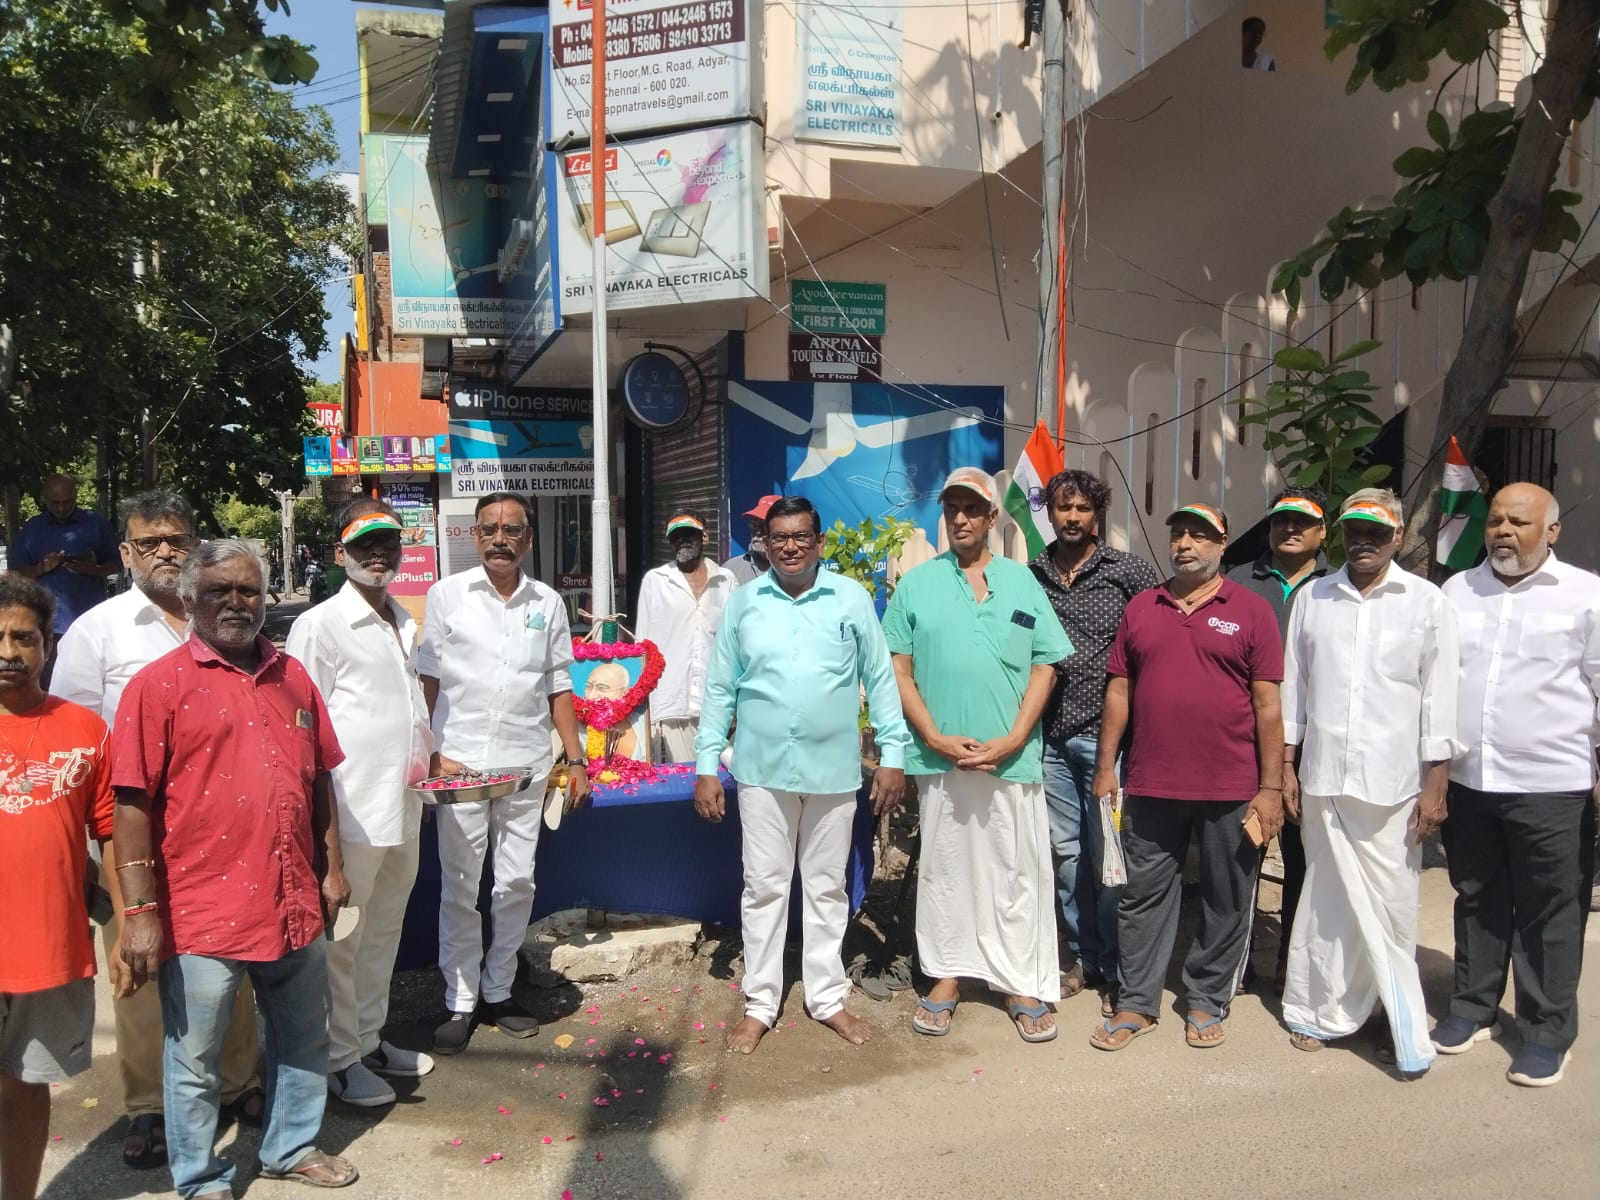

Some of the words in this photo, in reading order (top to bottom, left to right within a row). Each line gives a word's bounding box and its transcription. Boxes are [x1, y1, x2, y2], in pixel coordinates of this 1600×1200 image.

[561, 26, 573, 45] Ph
[580, 20, 628, 42] 042446
[631, 15, 655, 33] 1572
[661, 5, 706, 28] 044-2446
[708, 1, 733, 21] 1573
[563, 44, 593, 65] Mobile
[604, 38, 629, 59] 8380
[631, 35, 661, 55] 75606
[668, 28, 698, 48] 98410
[700, 22, 732, 43] 33713
[856, 50, 897, 63] Crompton
[604, 83, 641, 98] Chennai
[649, 80, 666, 93] 600
[669, 77, 690, 90] 020.
[806, 99, 827, 113] SRI
[831, 101, 895, 120] VINAYAKA
[807, 117, 893, 137] ELECTRICALS
[565, 285, 585, 298] SRI
[590, 278, 653, 295] NAYAKA
[657, 267, 748, 288] ELECTRICALS
[398, 317, 412, 329] Sri
[414, 318, 457, 332] Vinayaka
[803, 315, 836, 328] FIRST
[839, 317, 876, 330] FLOOR
[792, 349, 825, 363] TOURS
[825, 350, 834, 362] &
[837, 351, 878, 365] TRAVELS
[473, 388, 545, 410] iPhone
[391, 483, 410, 493] 50%
[458, 479, 475, 492] SRI
[479, 479, 528, 492] VINAYAKA
[562, 575, 588, 587] Shree
